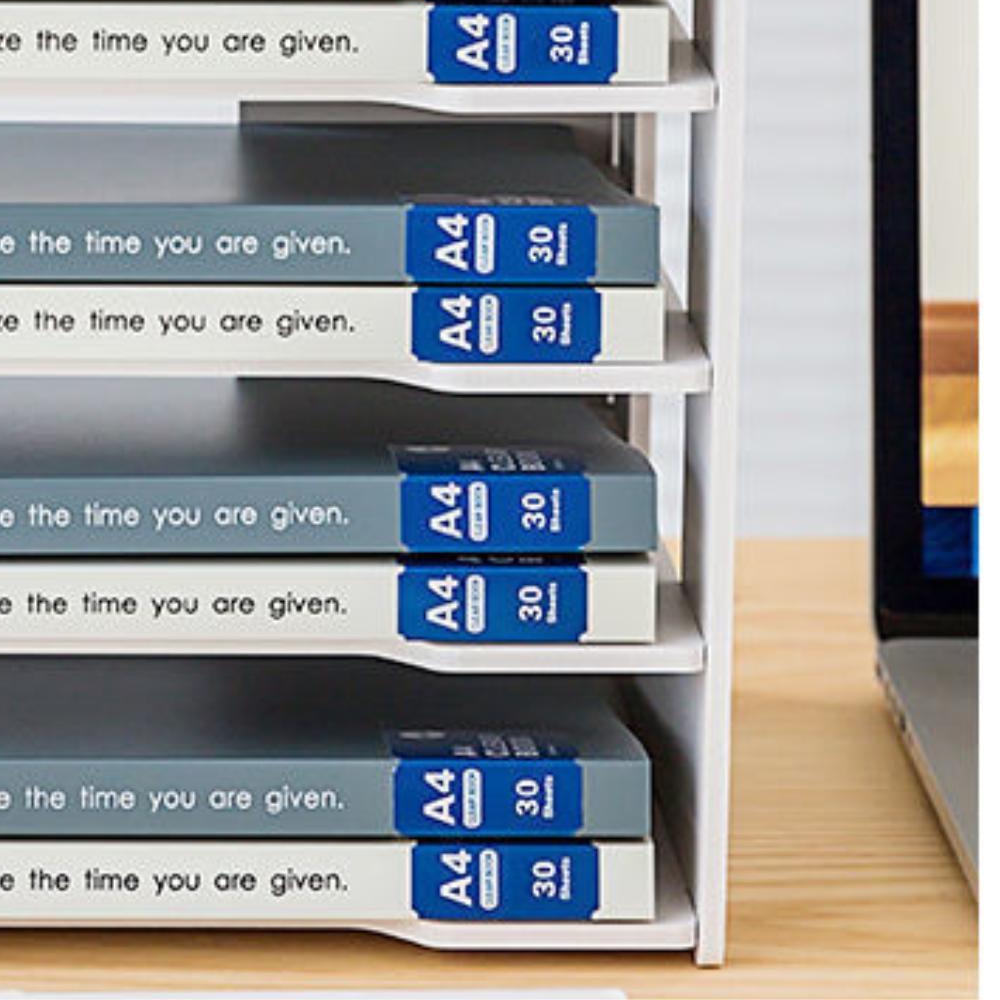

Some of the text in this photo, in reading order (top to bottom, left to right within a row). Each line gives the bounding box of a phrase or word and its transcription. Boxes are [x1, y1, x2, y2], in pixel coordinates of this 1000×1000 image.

[36, 29, 78, 53] the
[92, 29, 149, 54] time
[161, 32, 210, 57] you
[222, 33, 267, 54] are
[278, 29, 359, 59] given.
[455, 13, 490, 71] A4
[549, 24, 574, 63] 30
[576, 21, 590, 66] Sheets
[29, 230, 72, 255] the
[84, 230, 142, 255] time
[154, 235, 203, 259] you
[215, 235, 259, 255] are
[272, 230, 351, 260] given.
[434, 213, 470, 271] A4
[527, 225, 554, 263] 30
[555, 222, 569, 267] Sheets
[33, 310, 76, 333] the
[89, 309, 145, 333] time
[158, 314, 207, 336] you
[219, 314, 263, 333] are
[275, 309, 355, 339] given.
[439, 294, 473, 351] A4
[532, 305, 557, 343] 30
[559, 302, 572, 346] Sheets
[28, 503, 71, 528] the
[84, 501, 140, 527] time
[152, 506, 201, 531] you
[214, 506, 258, 526] are
[270, 501, 349, 531] given.
[428, 481, 464, 539] A4
[521, 492, 547, 530] 30
[549, 487, 562, 533] Sheets
[27, 592, 68, 615] the
[81, 591, 138, 615] time
[151, 596, 199, 619] you
[211, 596, 256, 615] are
[267, 591, 347, 621] given.
[425, 574, 460, 631] A4
[518, 584, 543, 622] 30
[546, 581, 558, 625] Sheets
[25, 785, 66, 810] the
[80, 785, 136, 810] time
[149, 790, 196, 813] you
[208, 790, 252, 810] are
[264, 784, 344, 815] given.
[422, 768, 457, 826] A4
[515, 779, 540, 817] 30
[541, 774, 555, 820] Sheets
[29, 868, 71, 892] the
[84, 867, 140, 892] time
[152, 872, 201, 897] you
[213, 872, 258, 892] are
[270, 867, 348, 898] given.
[440, 848, 473, 907] A4
[532, 860, 557, 898] 30
[558, 856, 572, 901] Sheets
